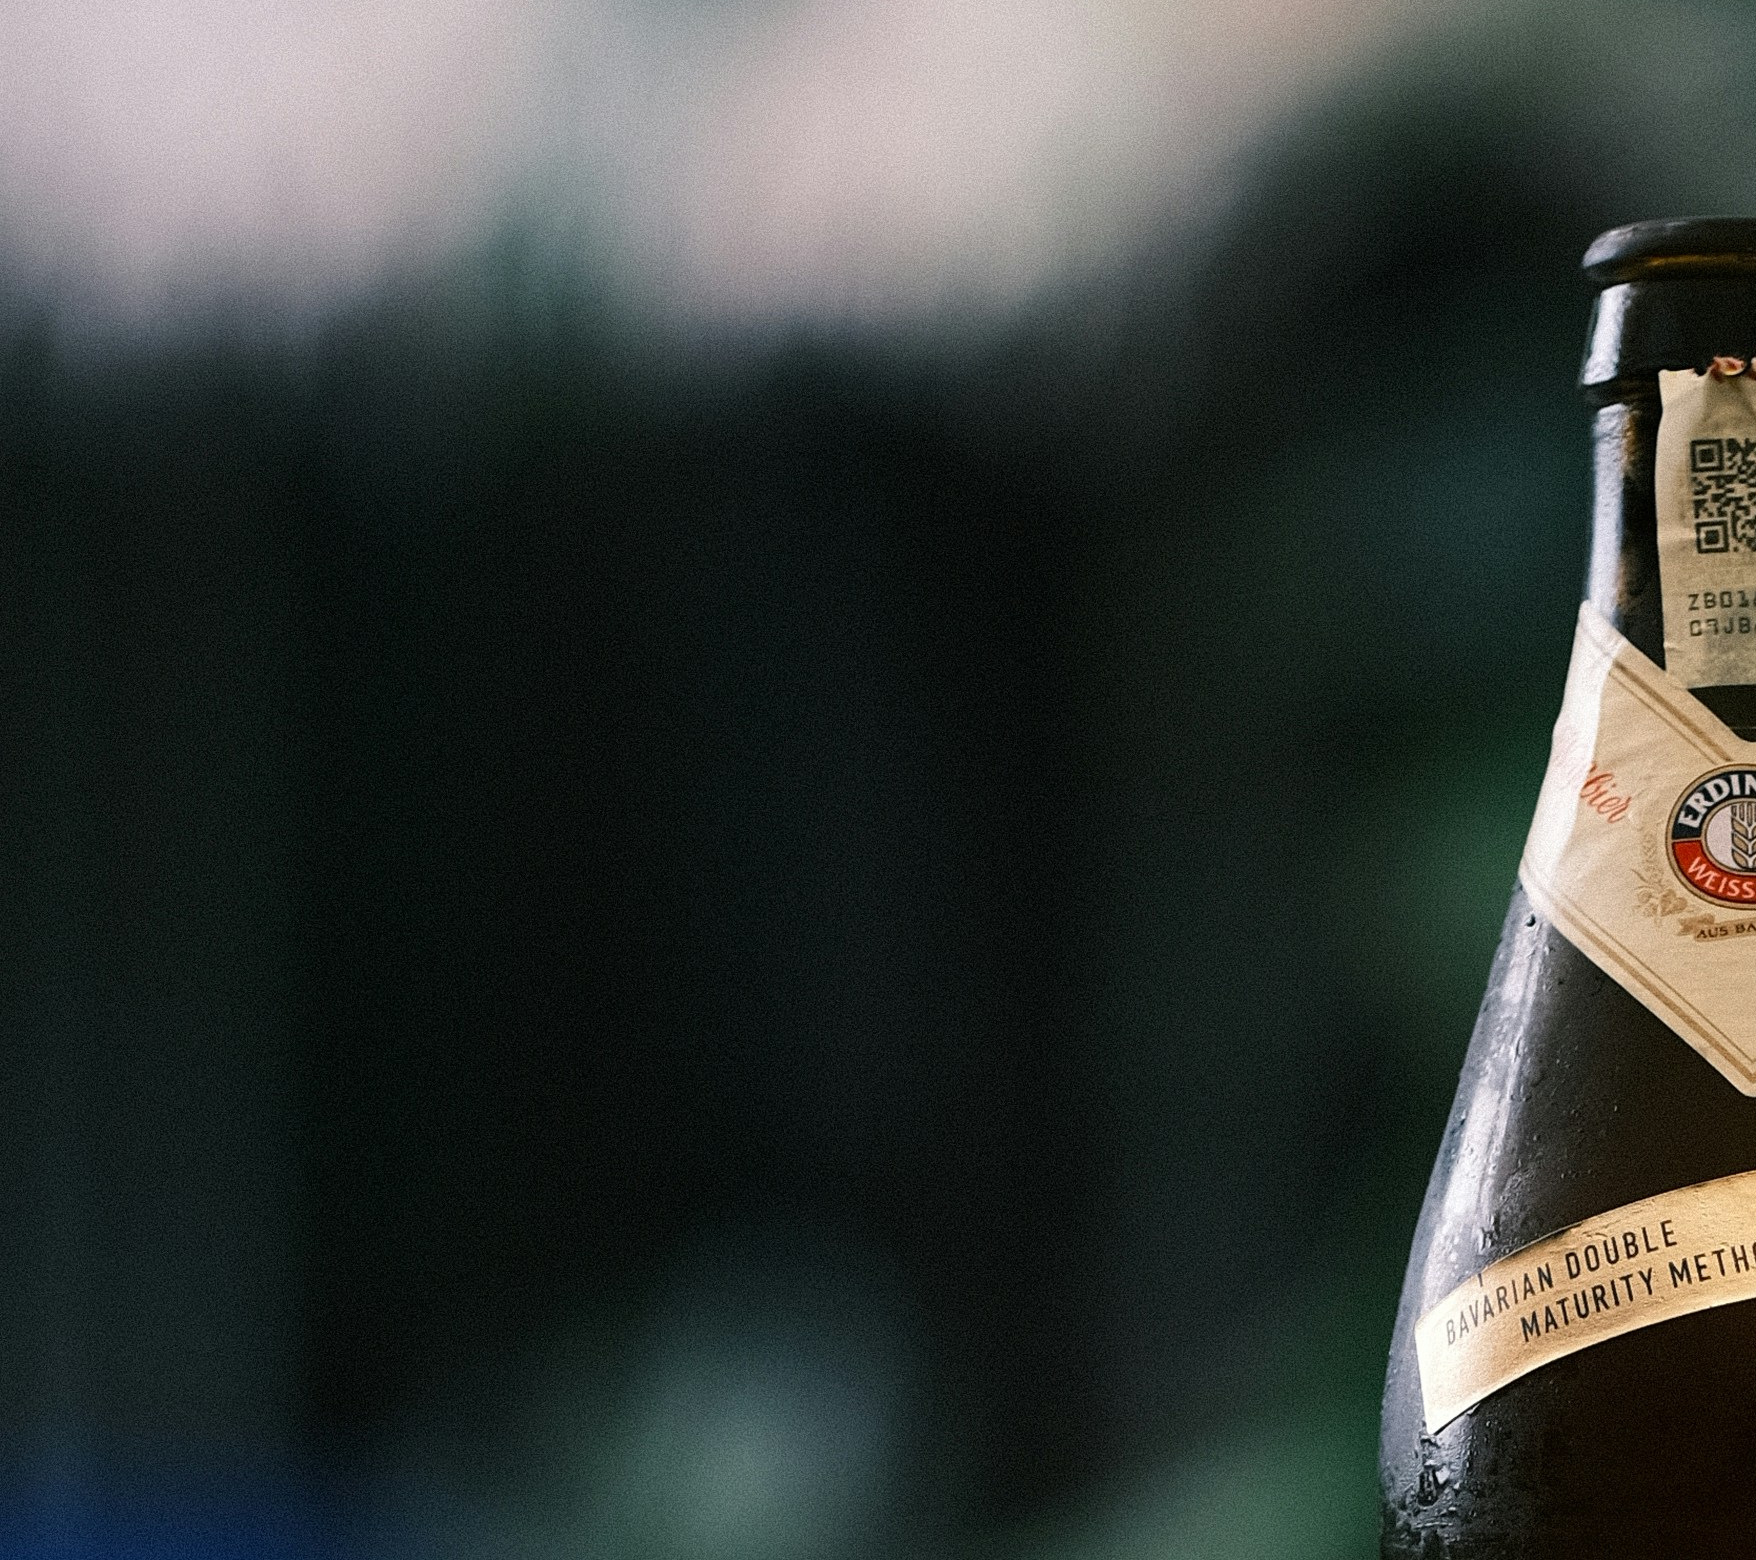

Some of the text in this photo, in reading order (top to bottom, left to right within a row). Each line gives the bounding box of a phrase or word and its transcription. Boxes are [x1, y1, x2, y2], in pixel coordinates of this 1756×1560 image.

[1696, 925, 1729, 940] AUS
[1446, 1219, 1678, 1346] BAVARIAN DOUBLE
[1520, 1267, 1655, 1343] MATURITY
